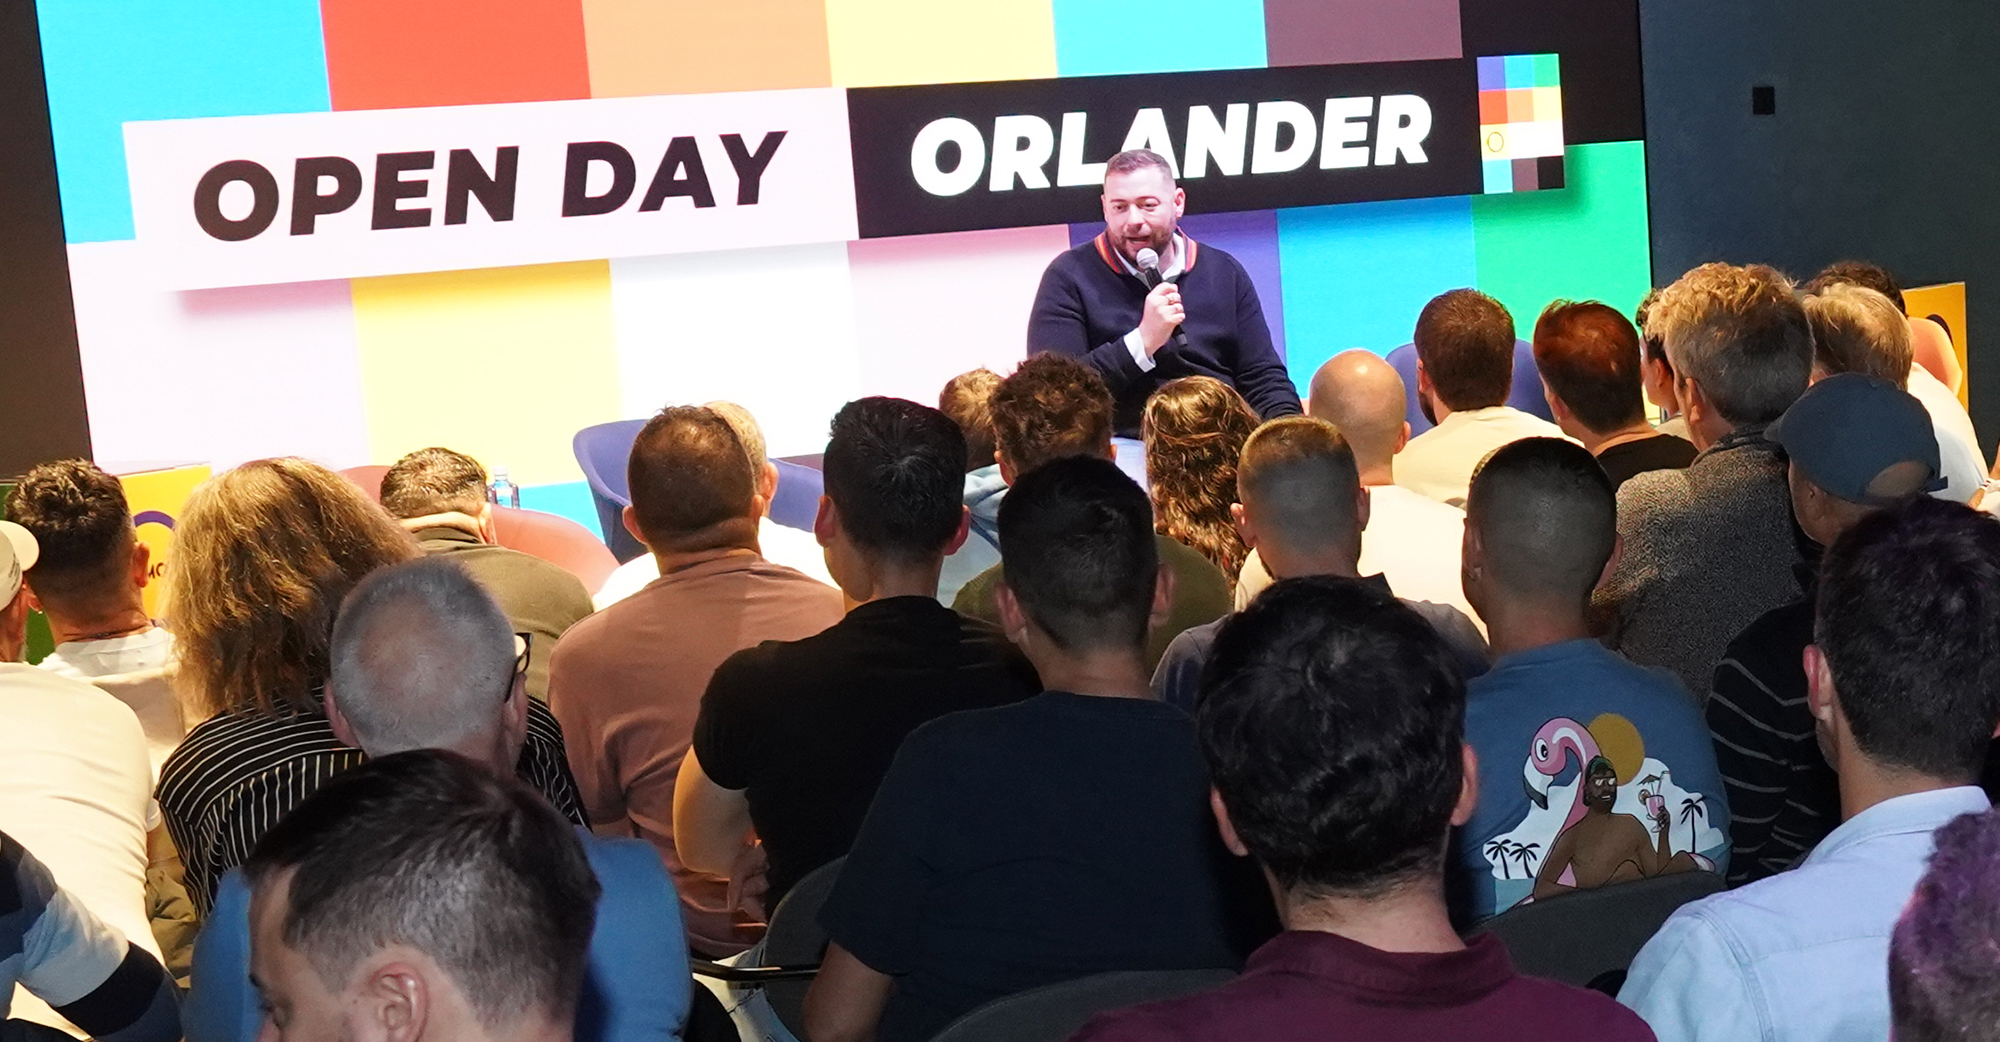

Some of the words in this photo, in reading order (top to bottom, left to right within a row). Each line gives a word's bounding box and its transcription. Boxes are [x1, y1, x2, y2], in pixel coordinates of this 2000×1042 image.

[193, 145, 519, 242] OPEN
[561, 130, 788, 218] DAY
[910, 94, 1432, 197] ORLANDER
